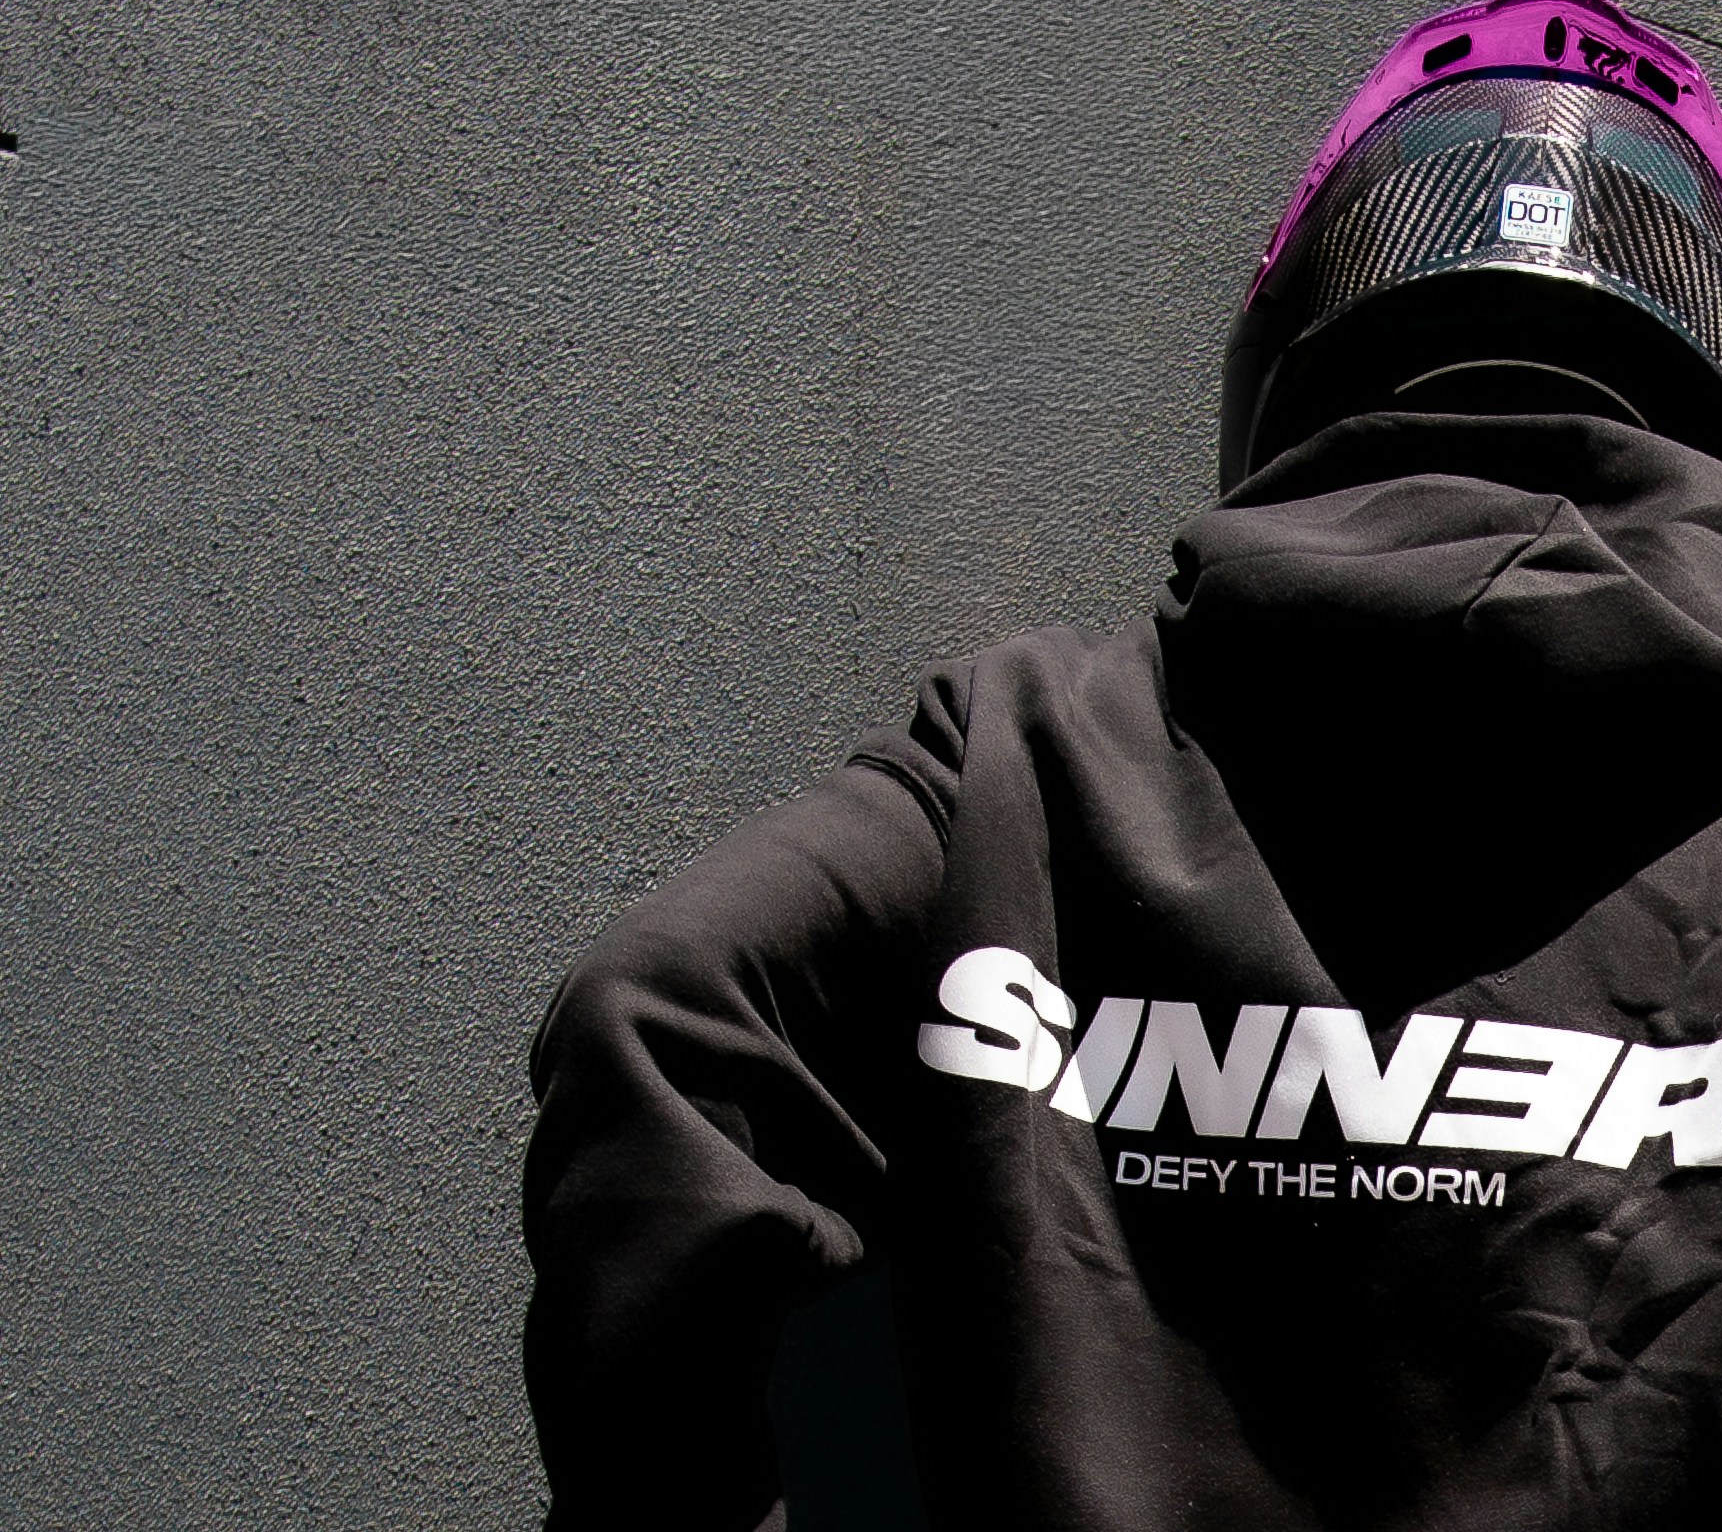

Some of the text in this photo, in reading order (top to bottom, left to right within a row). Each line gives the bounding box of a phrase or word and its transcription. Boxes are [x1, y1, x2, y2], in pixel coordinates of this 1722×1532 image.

[1507, 200, 1566, 226] DOT
[1115, 1150, 1507, 1208] DEFY THE NORM
